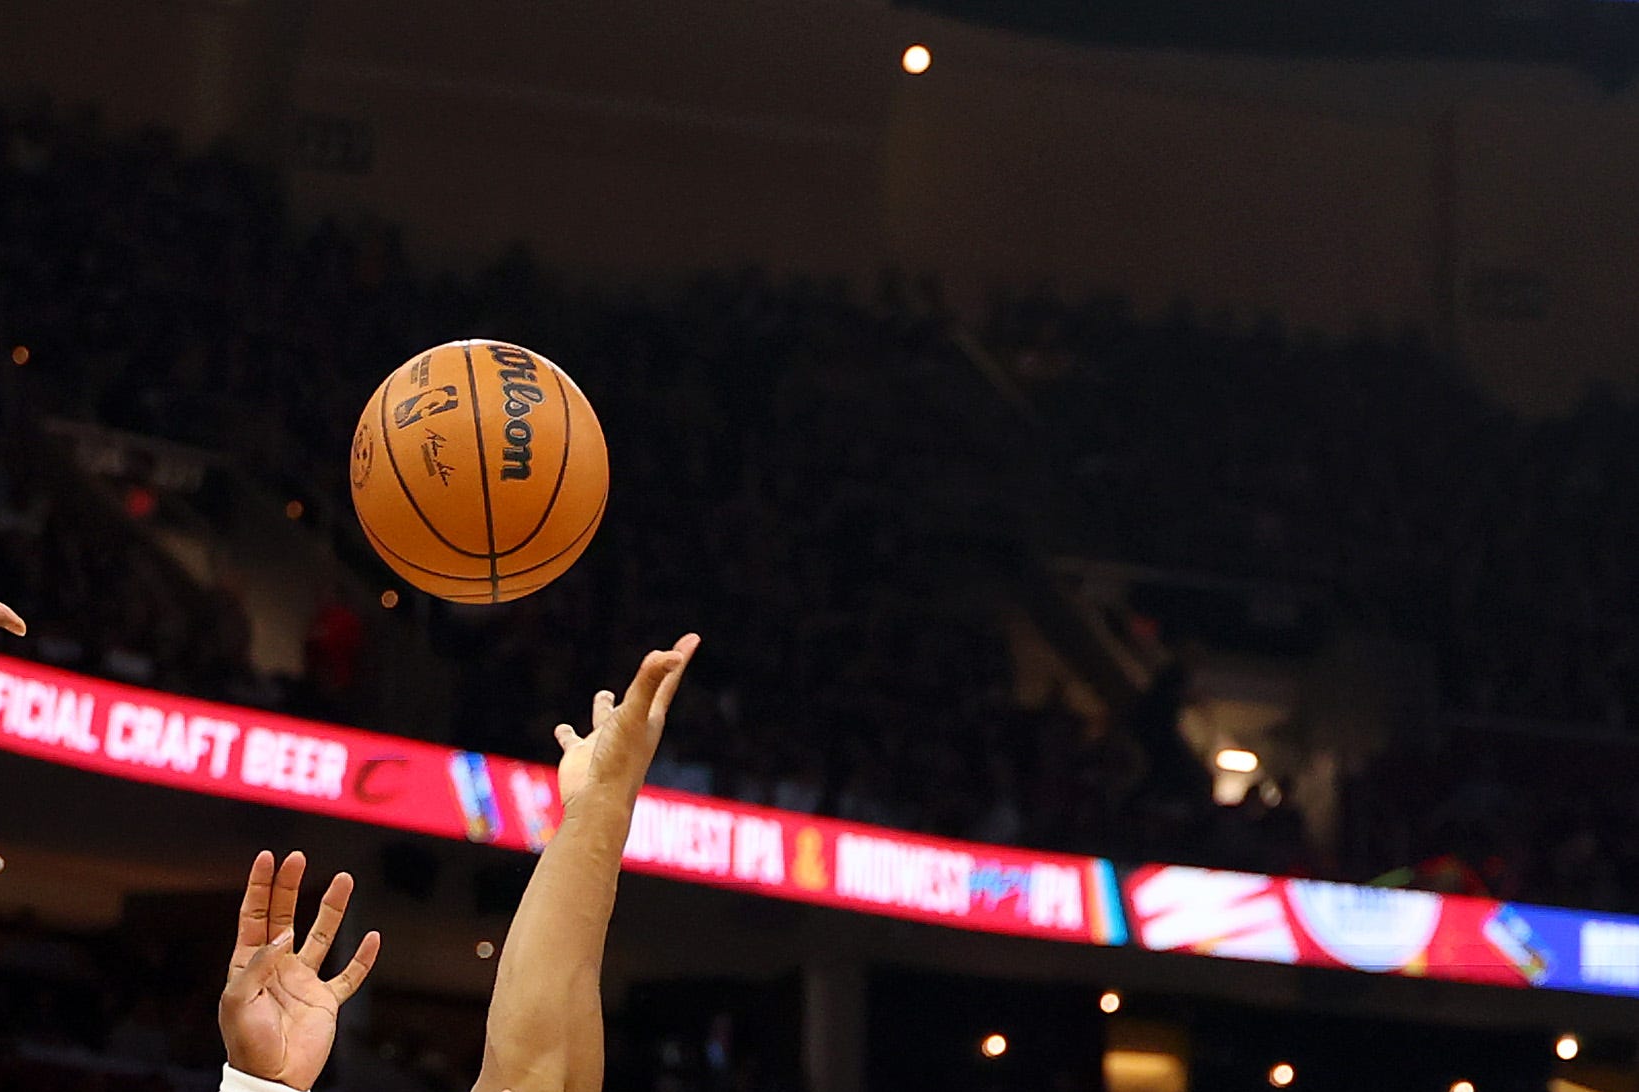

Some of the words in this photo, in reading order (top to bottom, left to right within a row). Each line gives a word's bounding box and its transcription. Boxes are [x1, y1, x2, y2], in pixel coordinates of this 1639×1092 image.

[486, 344, 546, 481] Wilson
[105, 701, 240, 779] CRAFT
[241, 726, 348, 800] BEER
[624, 796, 734, 875] DWEST
[792, 827, 828, 891] &
